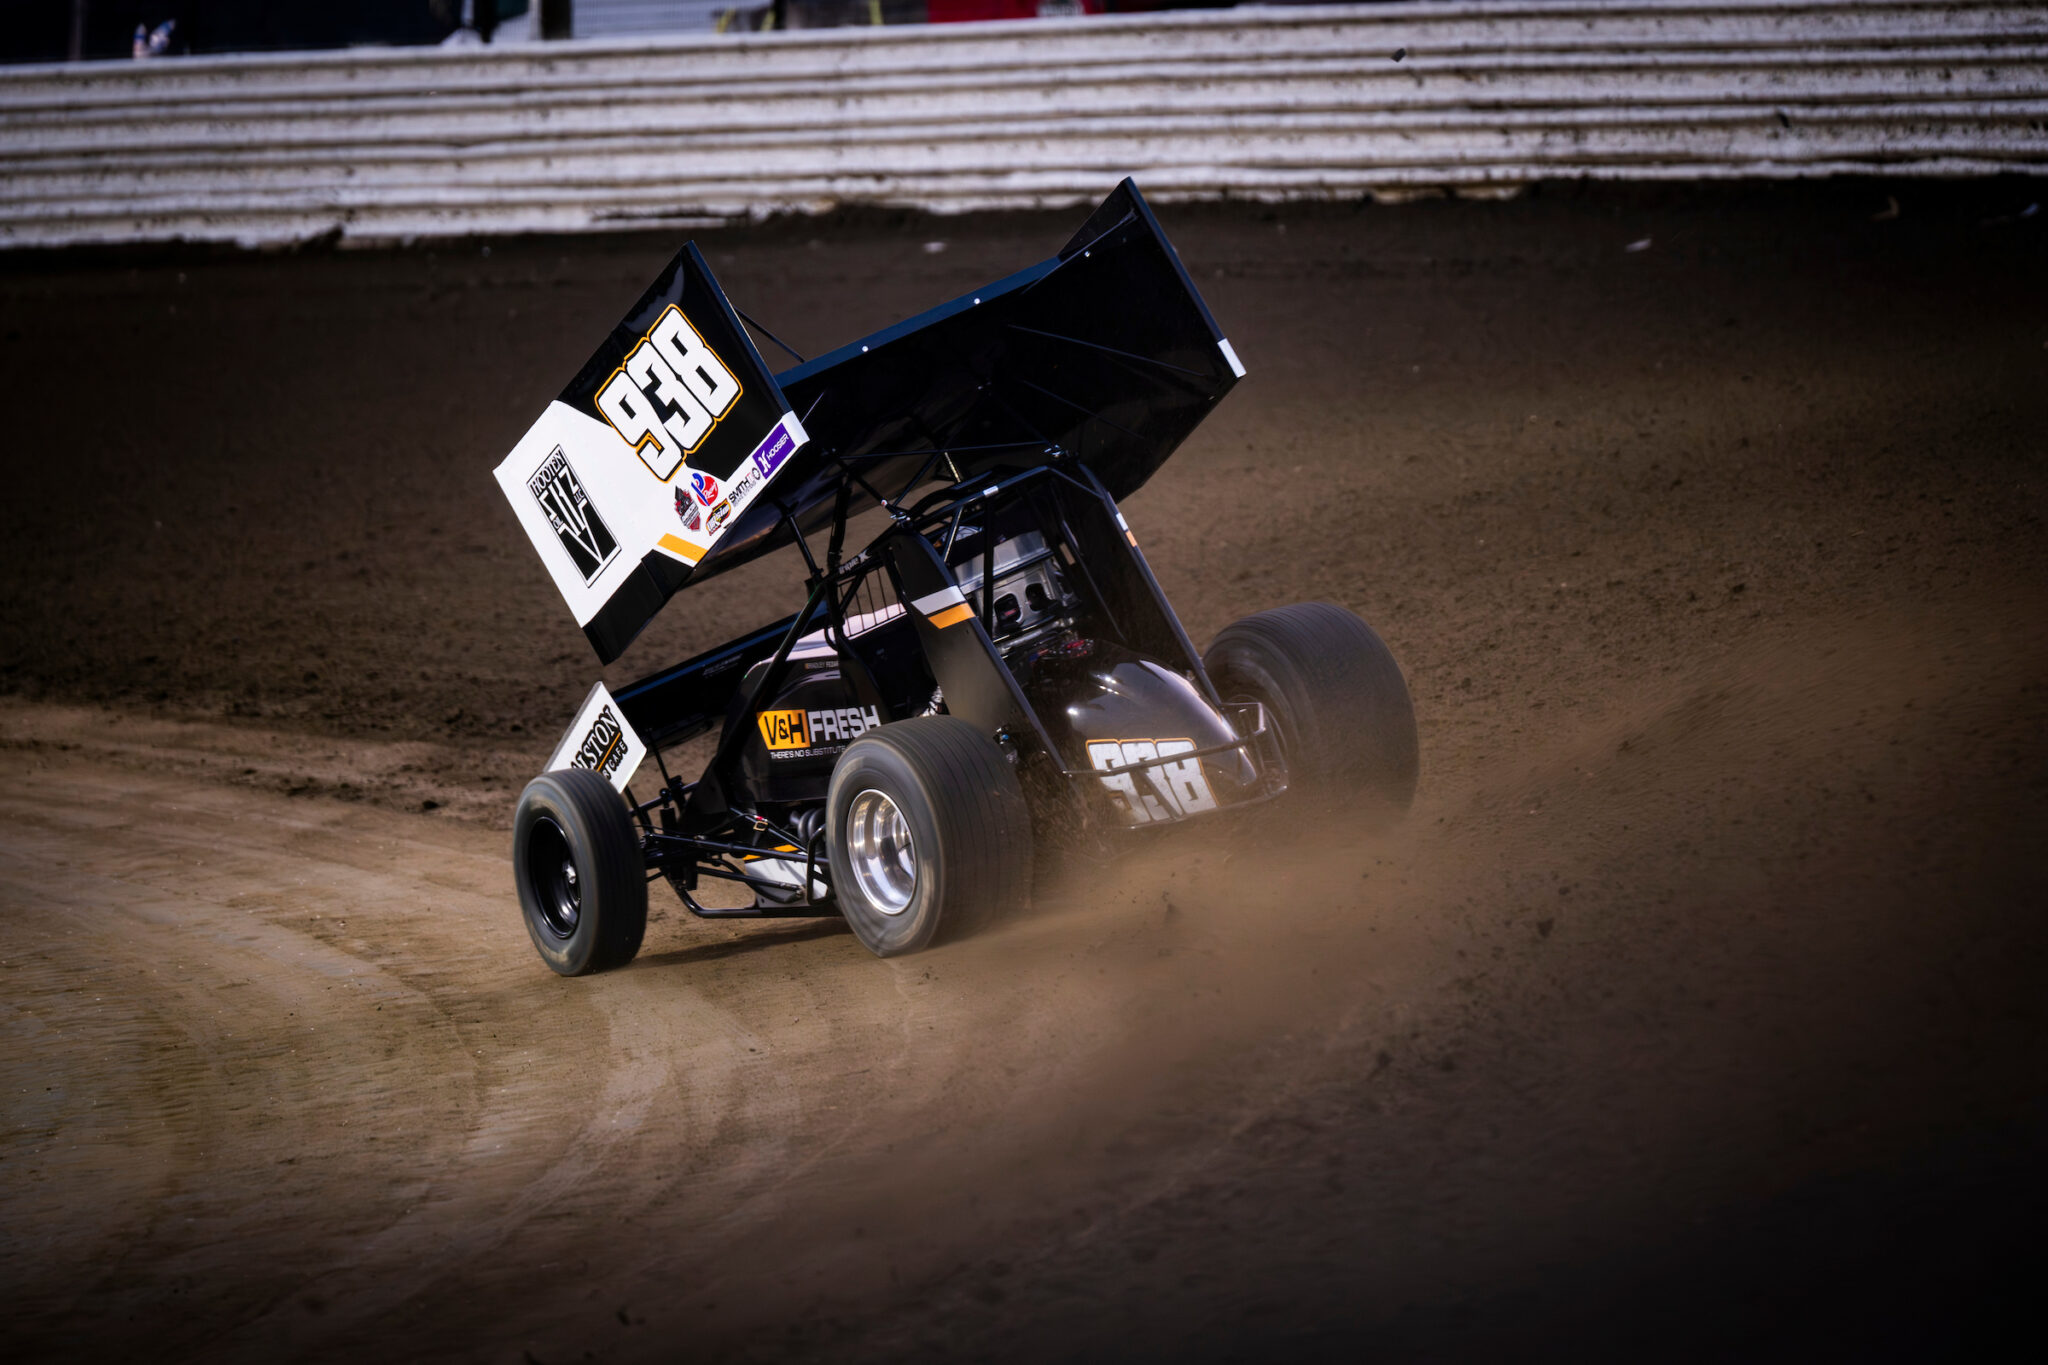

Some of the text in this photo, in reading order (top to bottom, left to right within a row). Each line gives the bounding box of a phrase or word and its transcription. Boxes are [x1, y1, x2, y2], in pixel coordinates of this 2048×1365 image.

[595, 304, 742, 483] 938
[765, 433, 790, 461] HOOSIER
[530, 450, 566, 497] HOOTEN
[764, 705, 881, 746] V&H FRESH
[608, 740, 627, 770] CAFE
[795, 749, 805, 758] NO
[1087, 739, 1220, 824] 938
